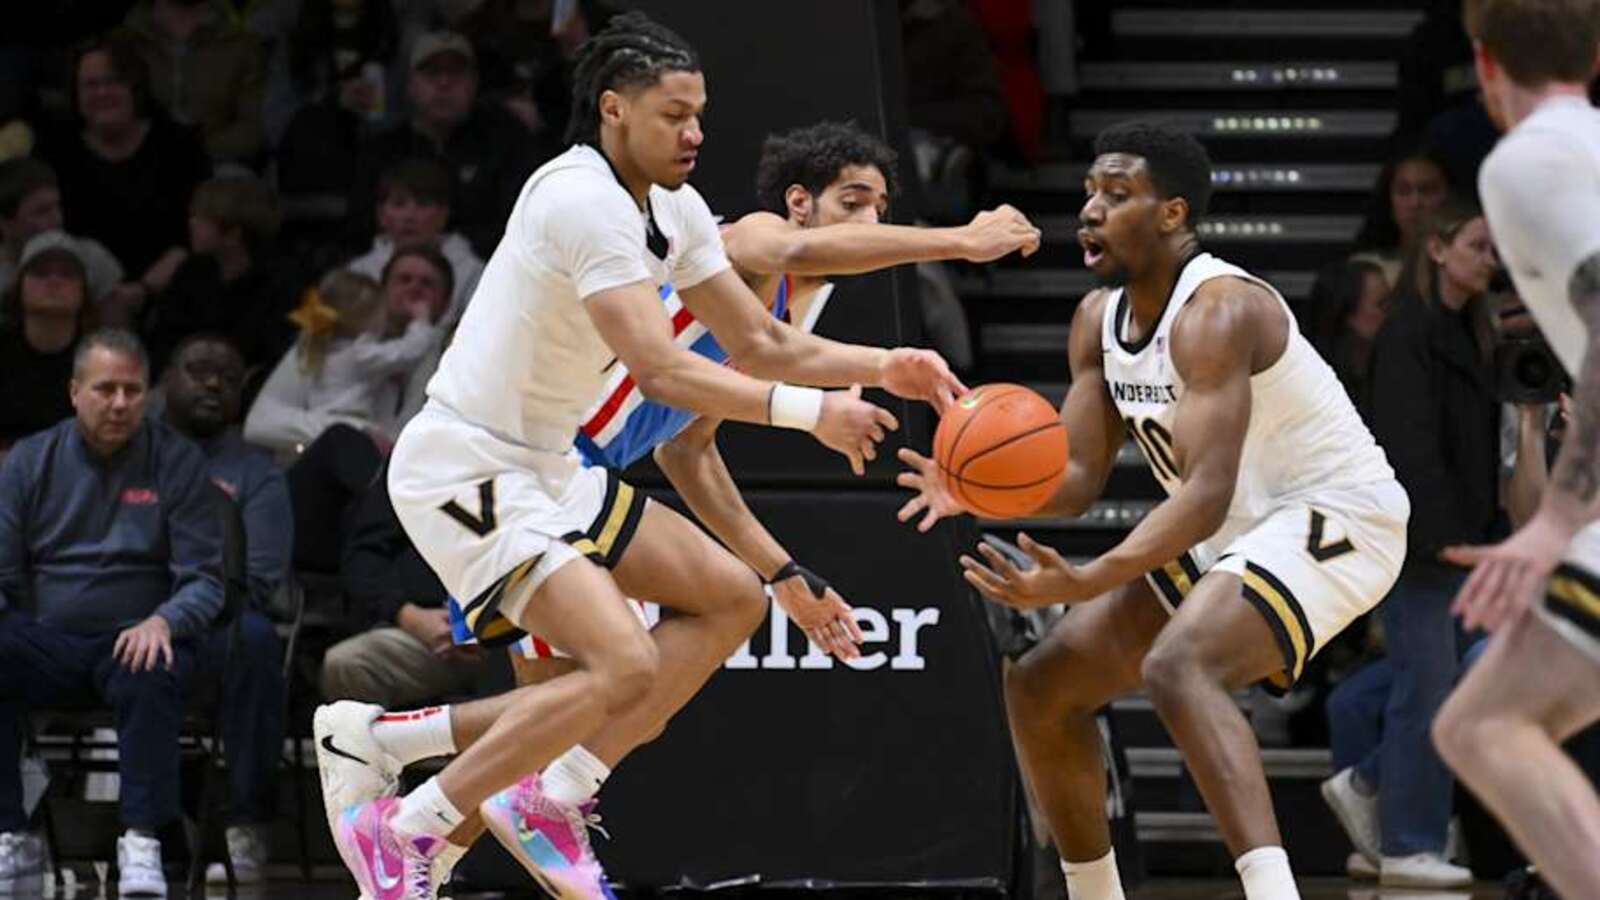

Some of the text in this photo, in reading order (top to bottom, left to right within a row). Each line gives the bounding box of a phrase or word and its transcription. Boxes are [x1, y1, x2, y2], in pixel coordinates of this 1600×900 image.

[1126, 416, 1180, 480] 10
[437, 478, 498, 539] V
[1306, 506, 1356, 562] V
